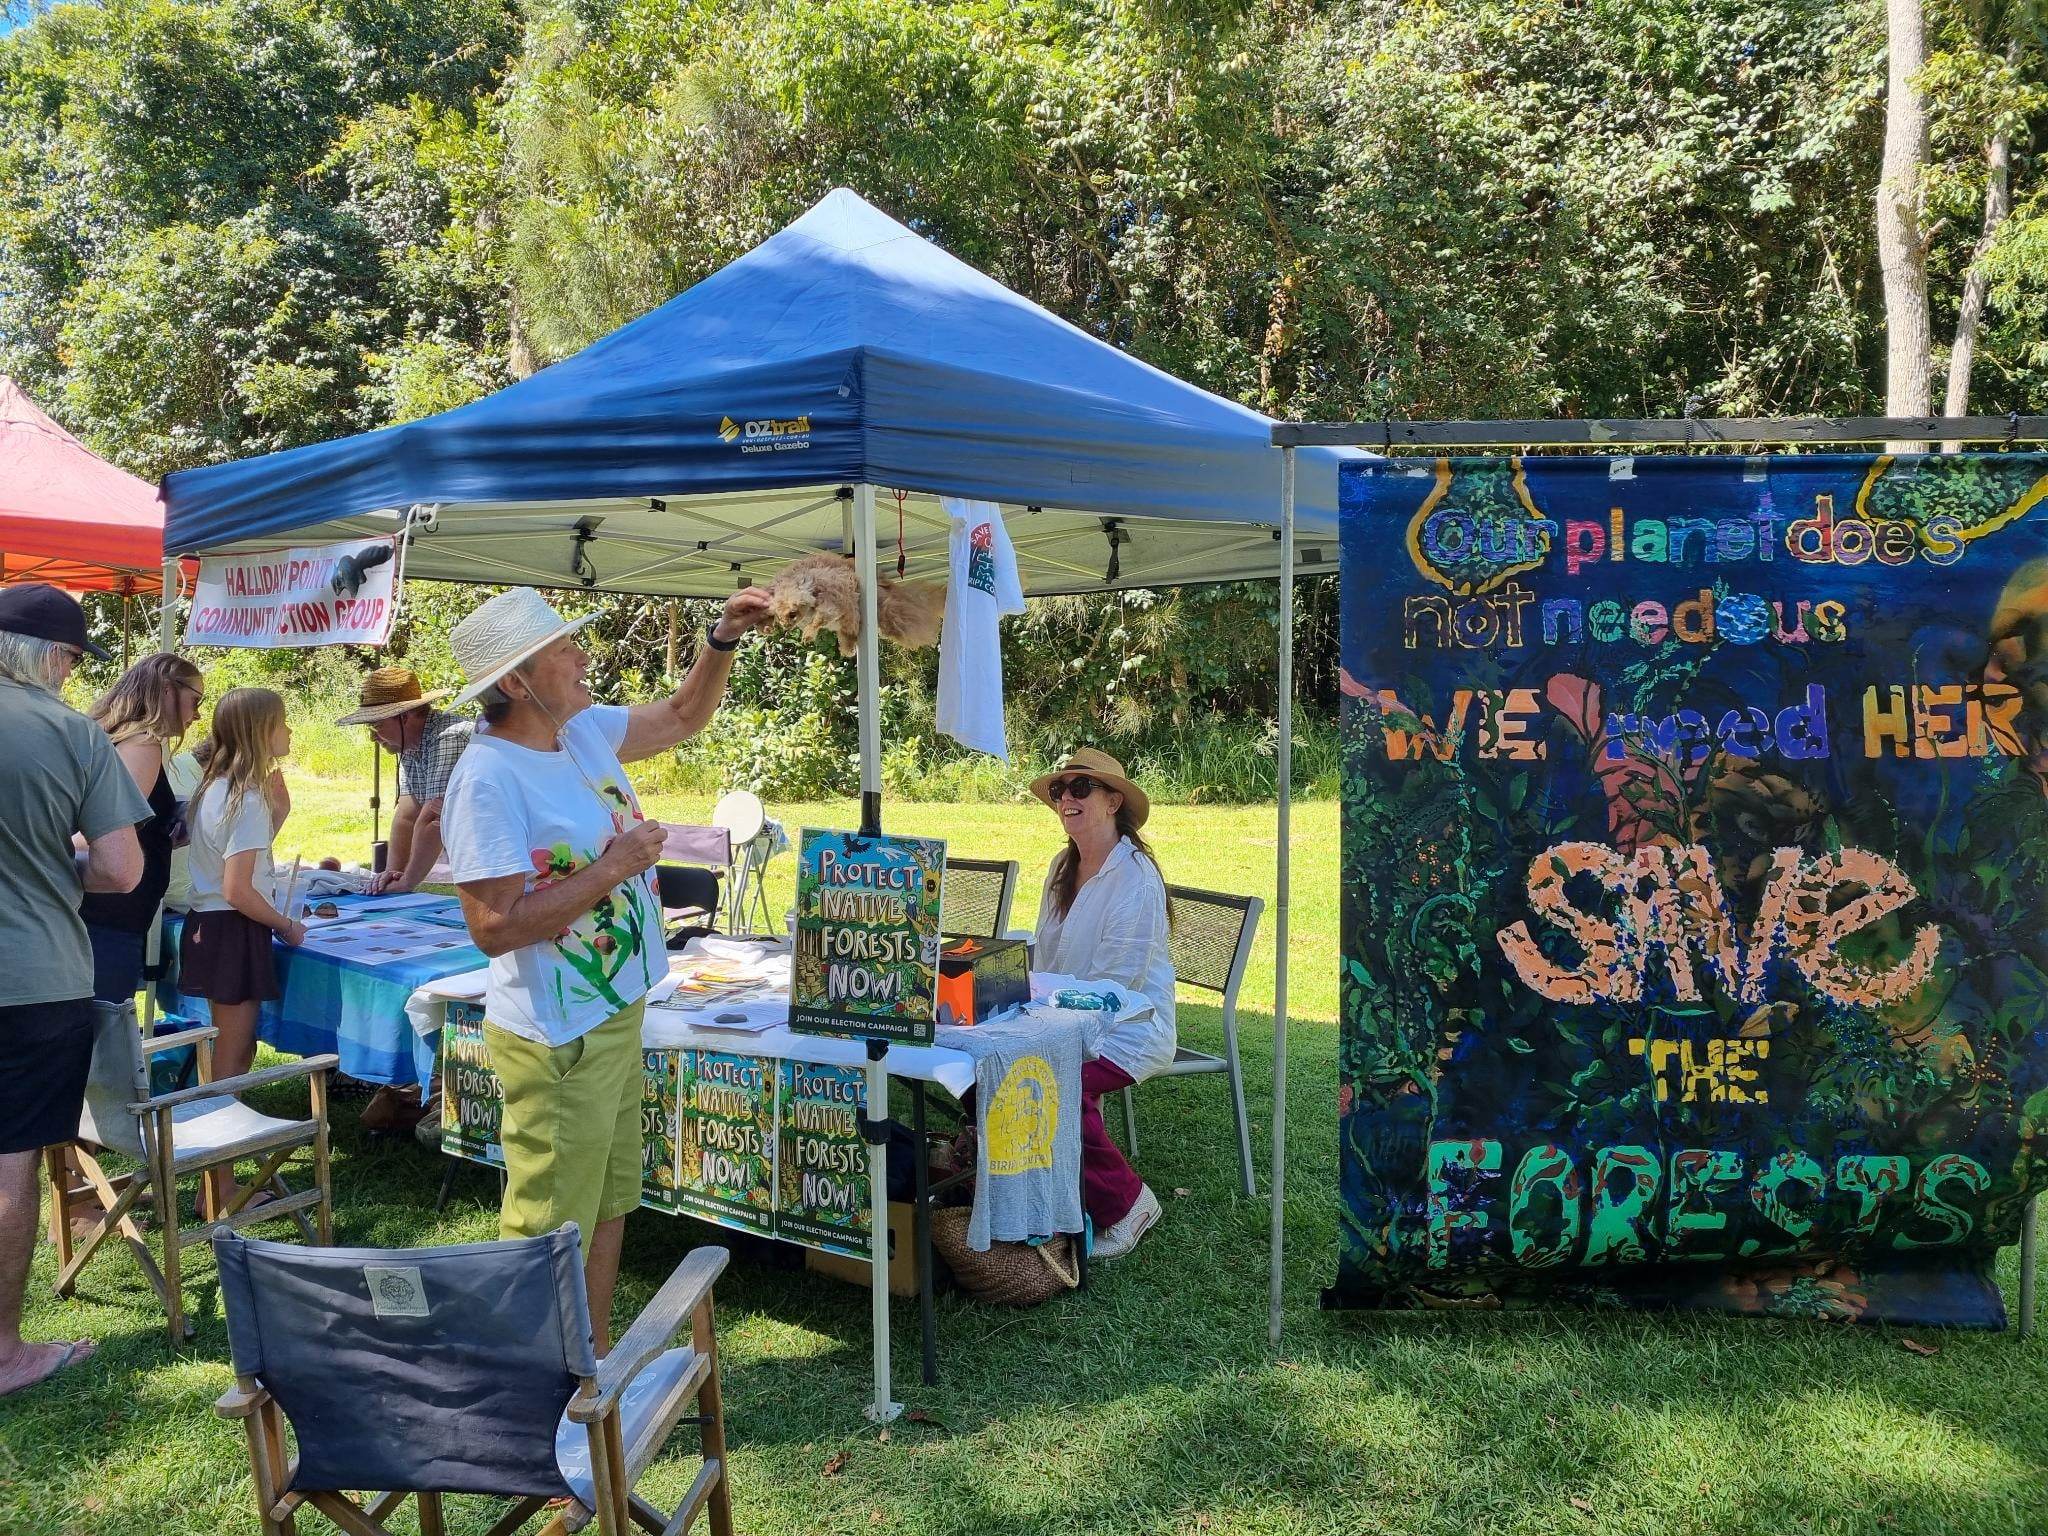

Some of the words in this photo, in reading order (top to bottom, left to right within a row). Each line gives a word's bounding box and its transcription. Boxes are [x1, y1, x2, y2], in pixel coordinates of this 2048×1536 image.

[741, 445, 773, 453] Deluxe
[774, 441, 810, 451] Gazebo
[1423, 508, 1558, 564] Our
[1565, 492, 1785, 575] planet
[1786, 494, 1966, 564] does
[288, 557, 334, 592] POINT
[1404, 582, 1535, 649] not
[1542, 589, 1715, 645] need
[1380, 688, 1547, 761] WE
[1606, 683, 1830, 761] need
[1863, 684, 2029, 761] HER
[820, 850, 919, 890] PROTECT
[822, 889, 904, 922] NATIVE
[821, 925, 916, 963] FORESTS
[829, 964, 901, 1001] NOW!
[456, 1008, 482, 1036] PROT
[796, 1014, 813, 1023] JOIN
[814, 1016, 830, 1025] OUR
[831, 1018, 866, 1029] ELECTION
[867, 1023, 909, 1033] CAMPAIGN
[456, 1068, 504, 1101] FORESTS
[696, 1050, 761, 1088] PROTECT
[794, 1063, 864, 1102] PROTECT
[1628, 1038, 1769, 1104] THE
[461, 1098, 497, 1130] NOW!
[698, 1084, 750, 1118] NATIVE
[795, 1100, 855, 1135] NATIVE
[697, 1117, 759, 1155] FORESTS
[796, 1136, 865, 1173] FORESTS
[702, 1151, 750, 1190] NOW!
[705, 1200, 729, 1213] ELECTION
[803, 1173, 856, 1211] NOW!
[1426, 1138, 1992, 1271] FORESTS
[805, 1226, 832, 1237] ELECTION
[832, 1232, 863, 1244] CAMPAIGN
